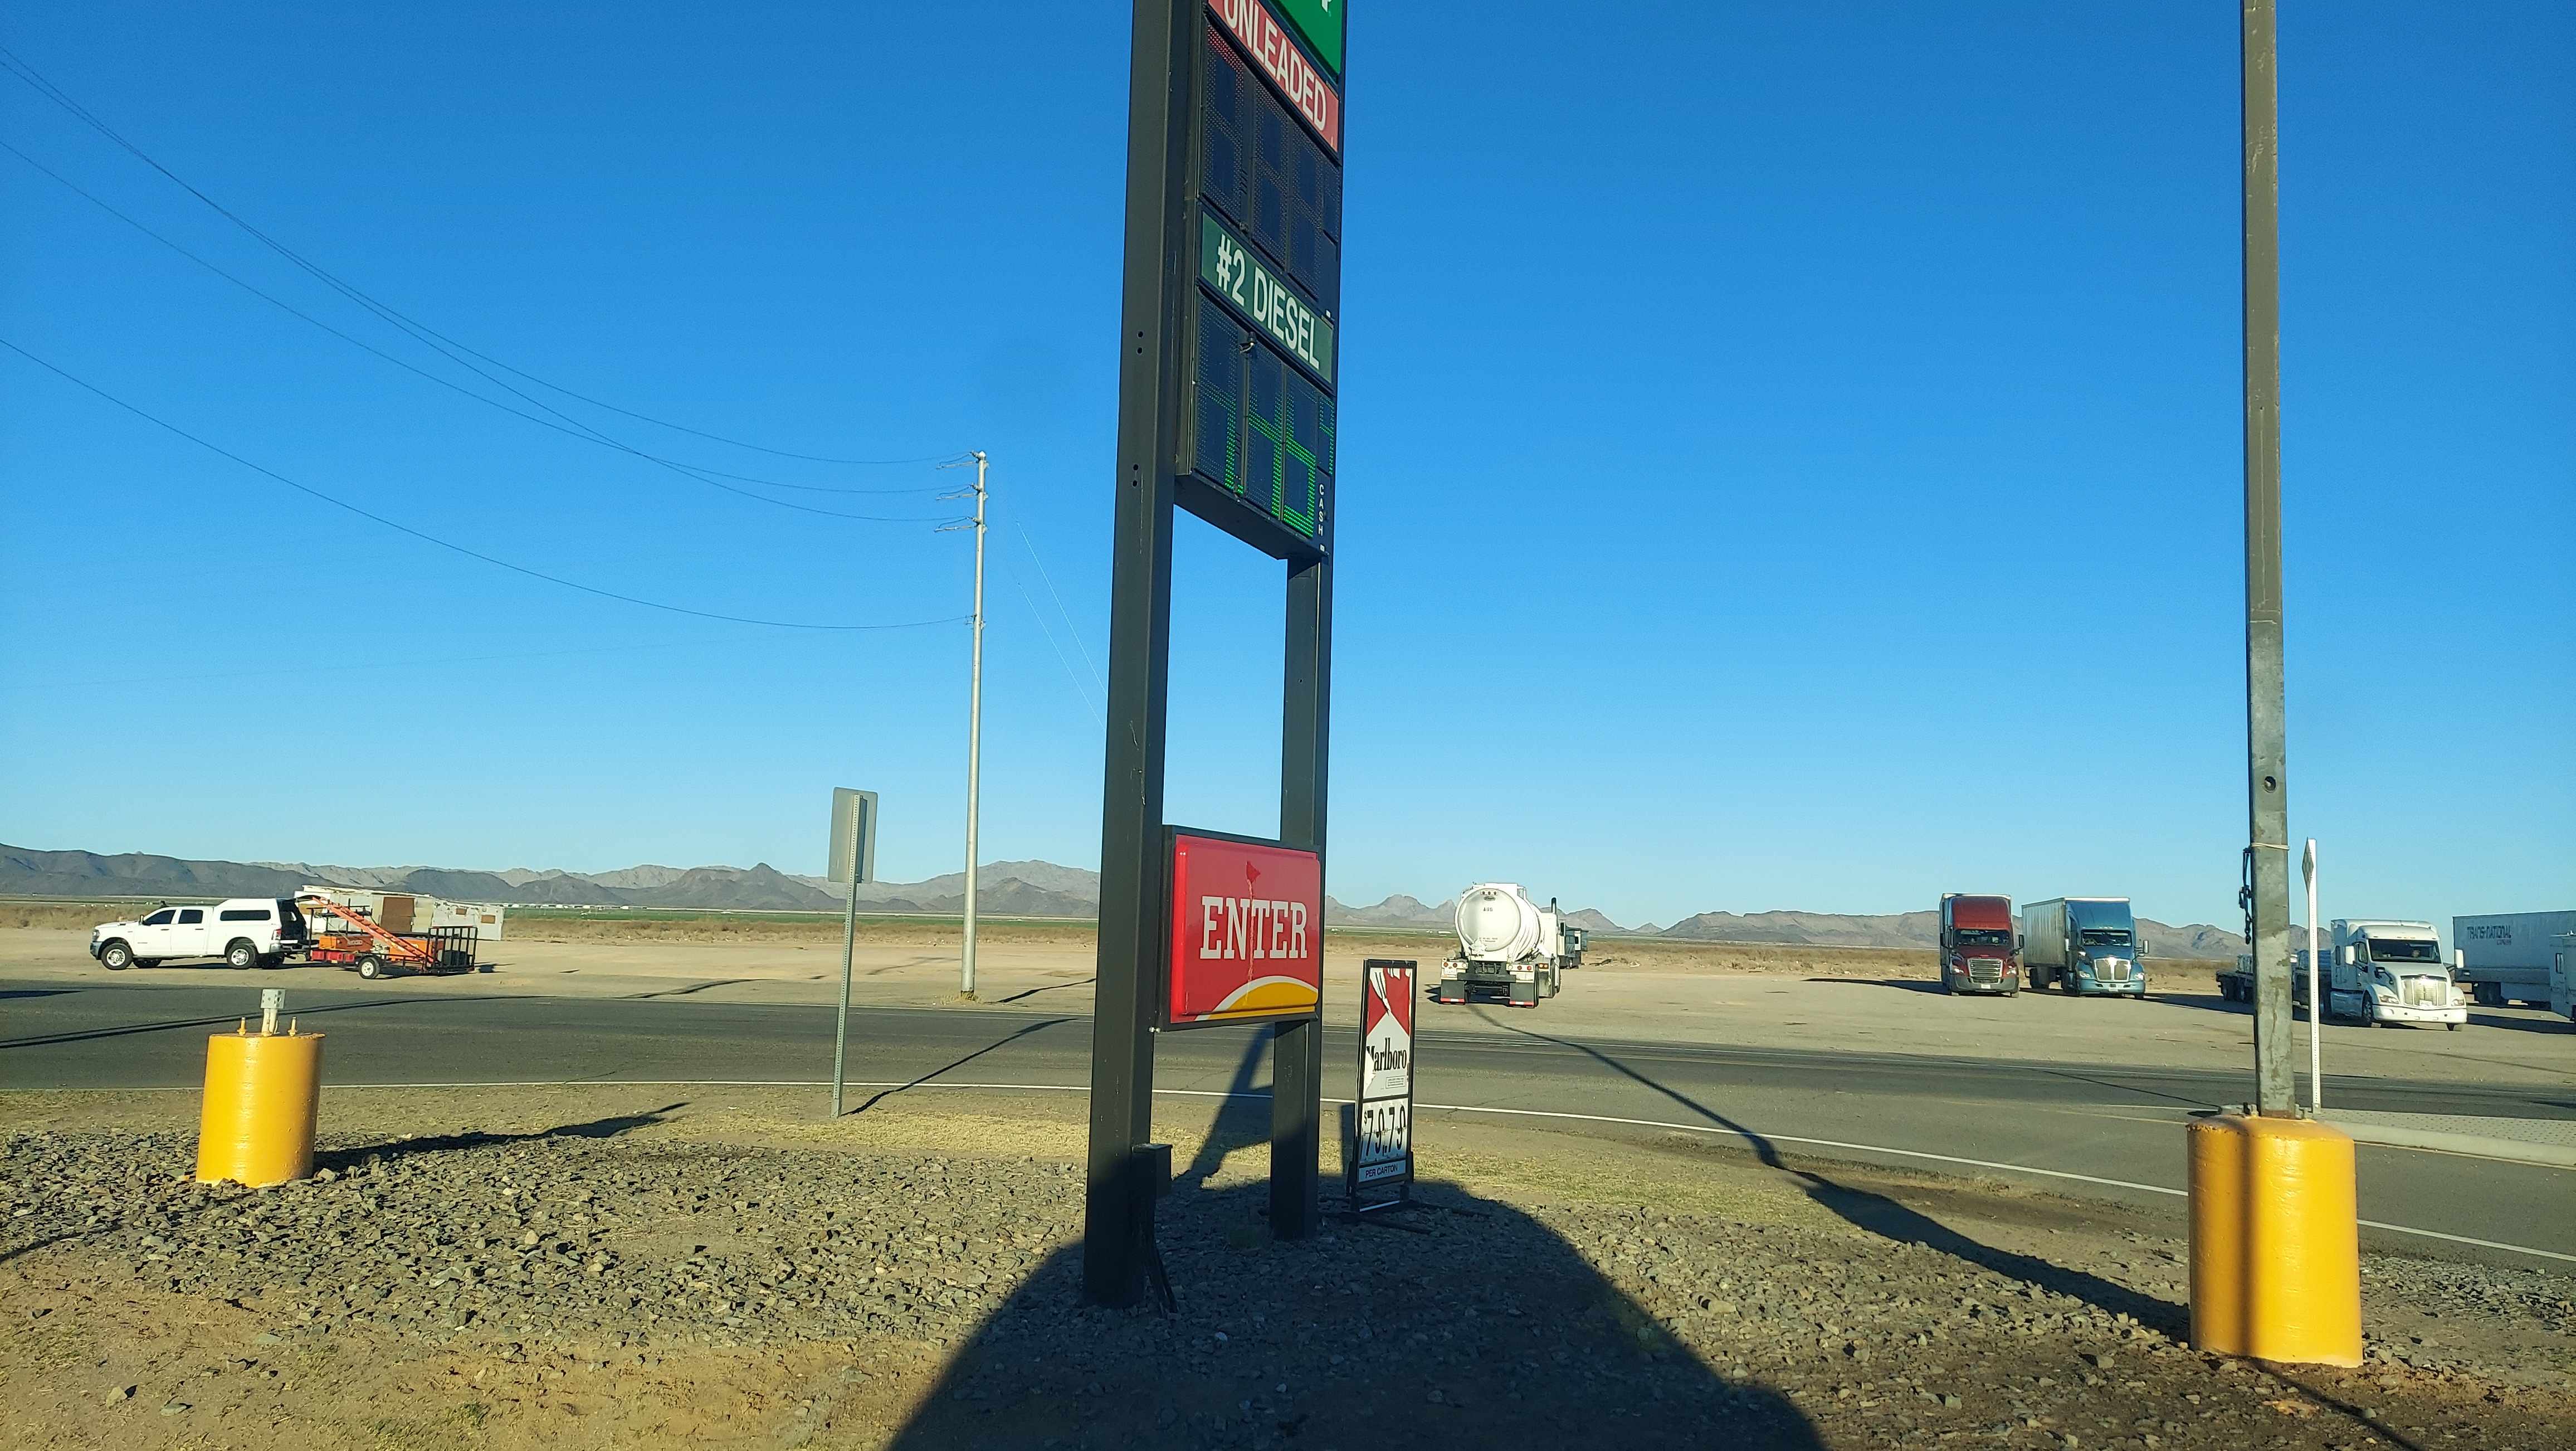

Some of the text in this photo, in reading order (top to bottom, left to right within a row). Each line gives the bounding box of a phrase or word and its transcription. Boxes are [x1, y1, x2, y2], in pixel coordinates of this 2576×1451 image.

[1215, 233, 1320, 371] #2 DIESEL
[1199, 895, 1308, 961] ENTER
[1365, 1163, 1398, 1179] PER CARTON
